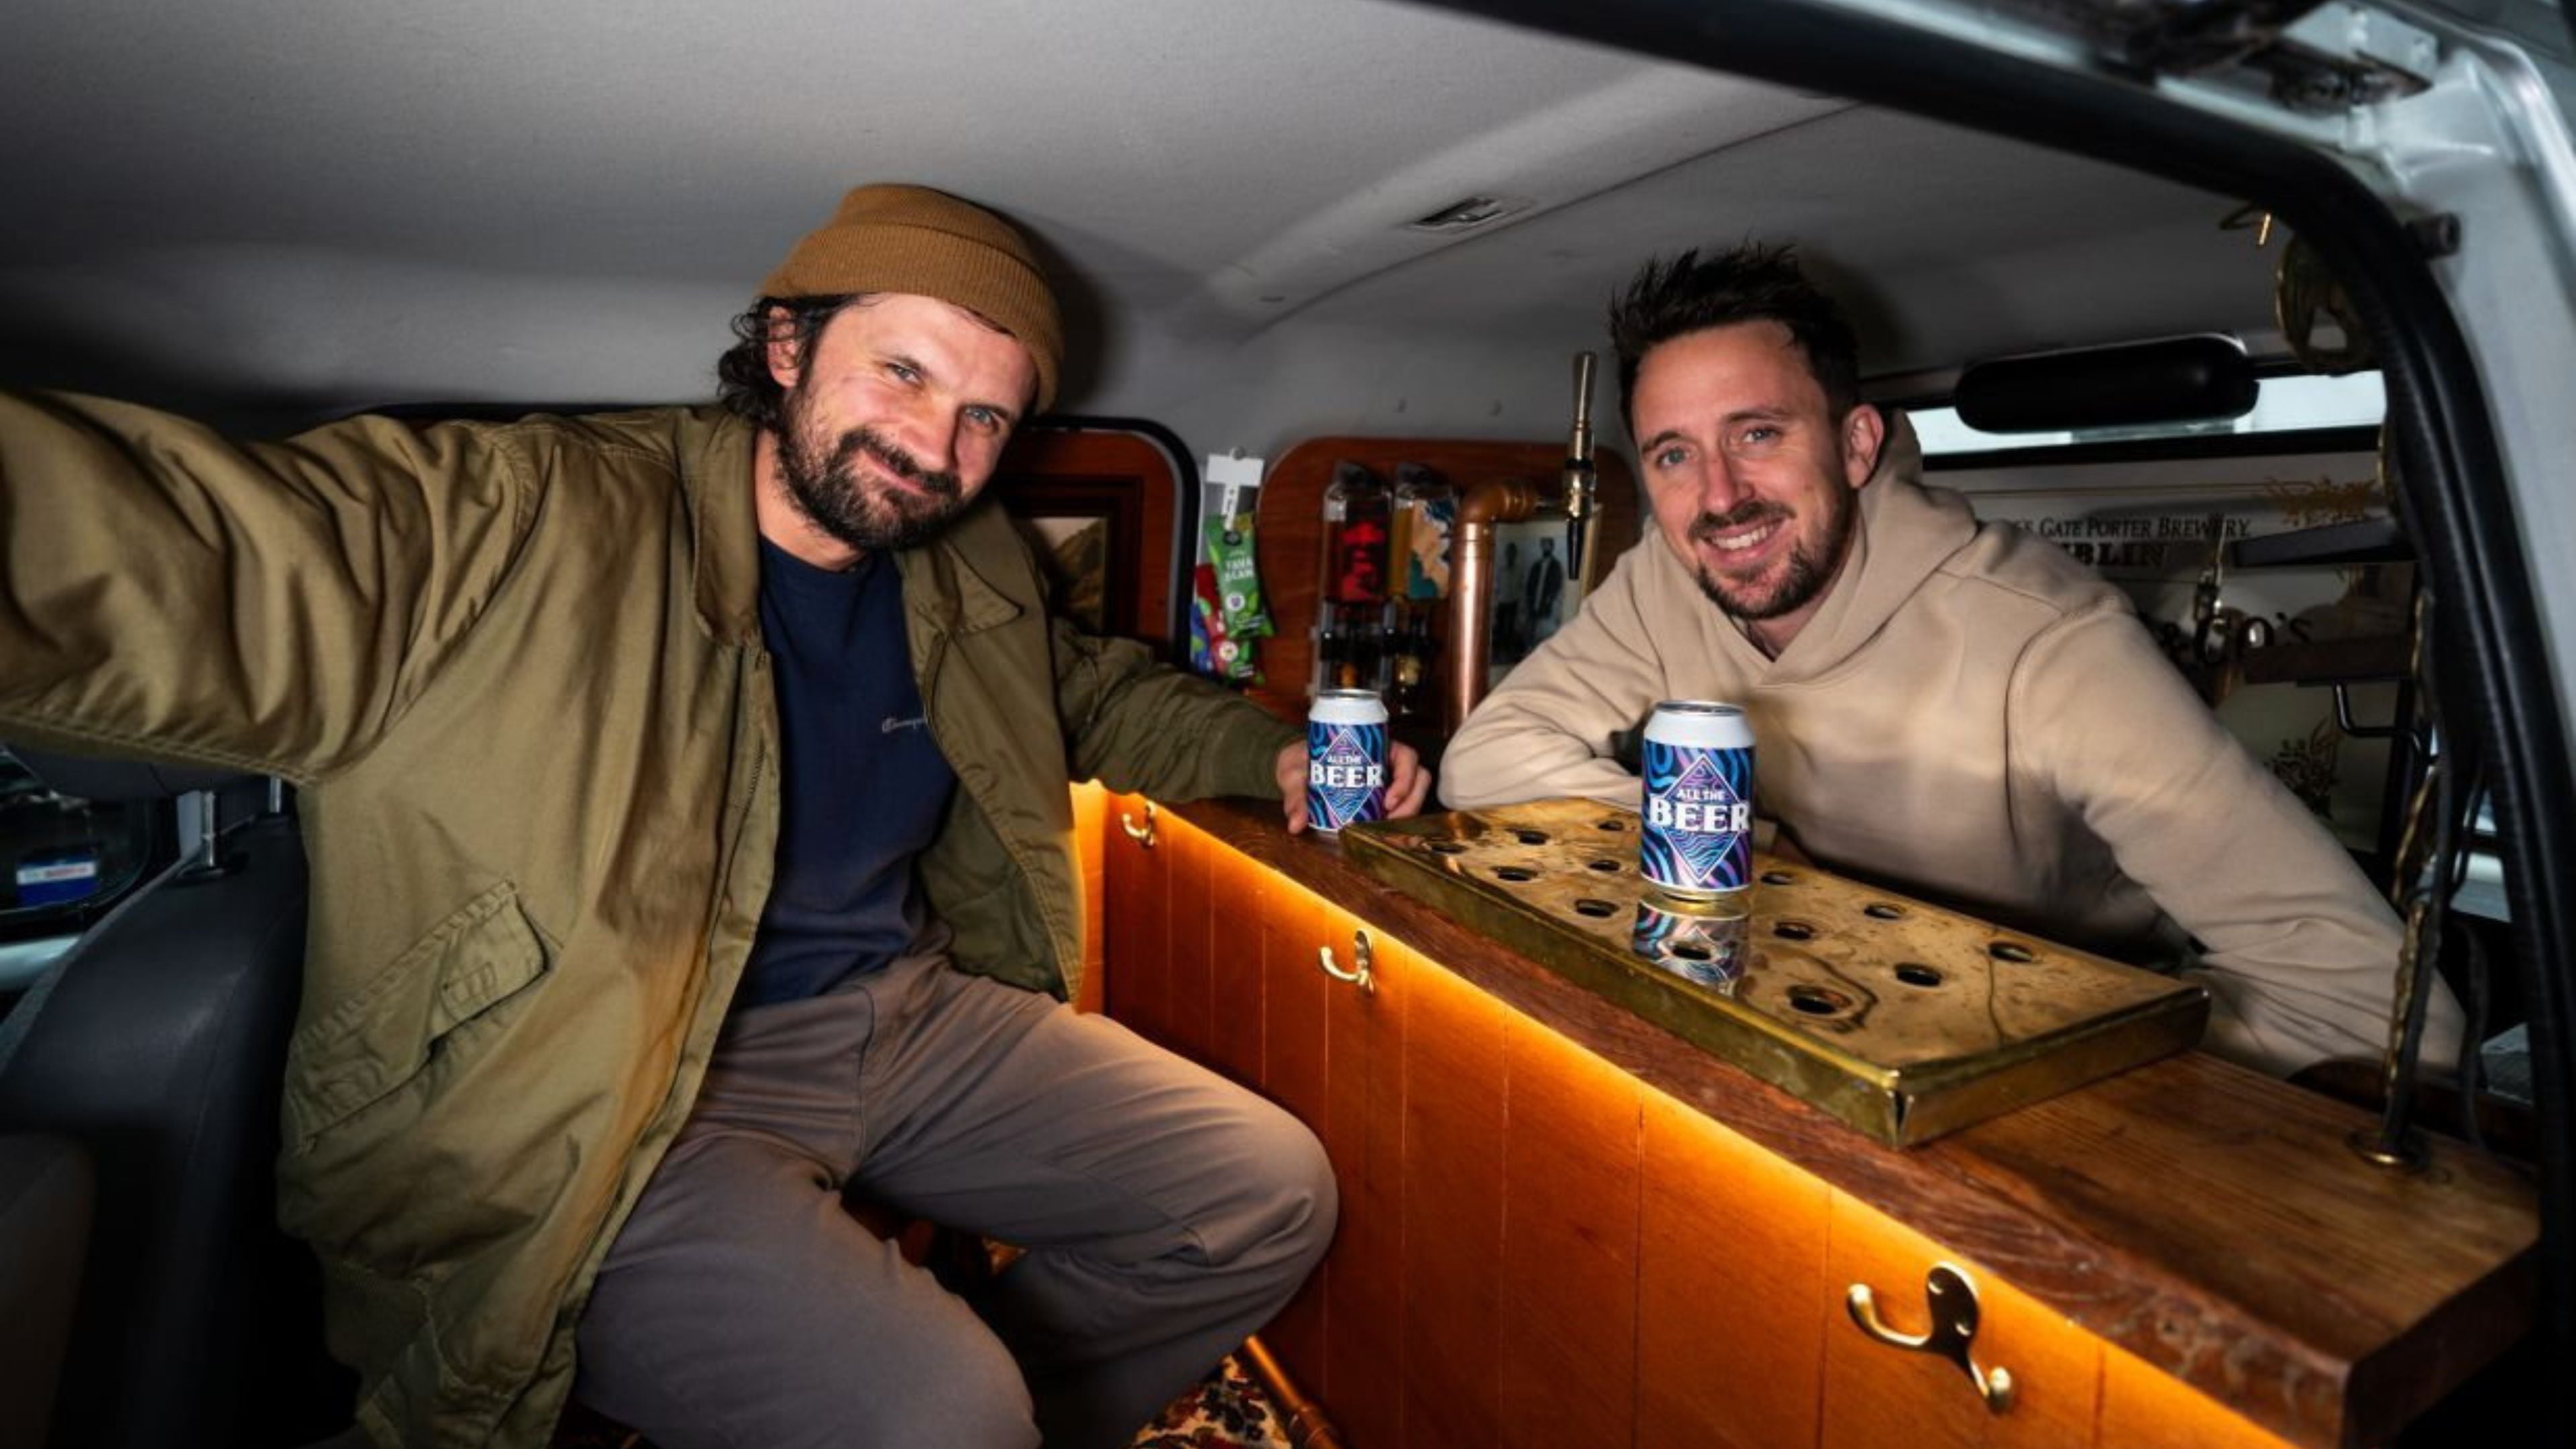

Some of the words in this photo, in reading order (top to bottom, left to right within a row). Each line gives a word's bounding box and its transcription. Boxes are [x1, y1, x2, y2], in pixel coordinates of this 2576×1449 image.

[2087, 516, 2151, 537] PORTER
[2062, 542, 2167, 566] BLIN
[1310, 760, 1383, 788] BEER
[1676, 788, 1700, 800] ALL
[1702, 789, 1725, 800] THE
[1650, 794, 1750, 831] BEER
